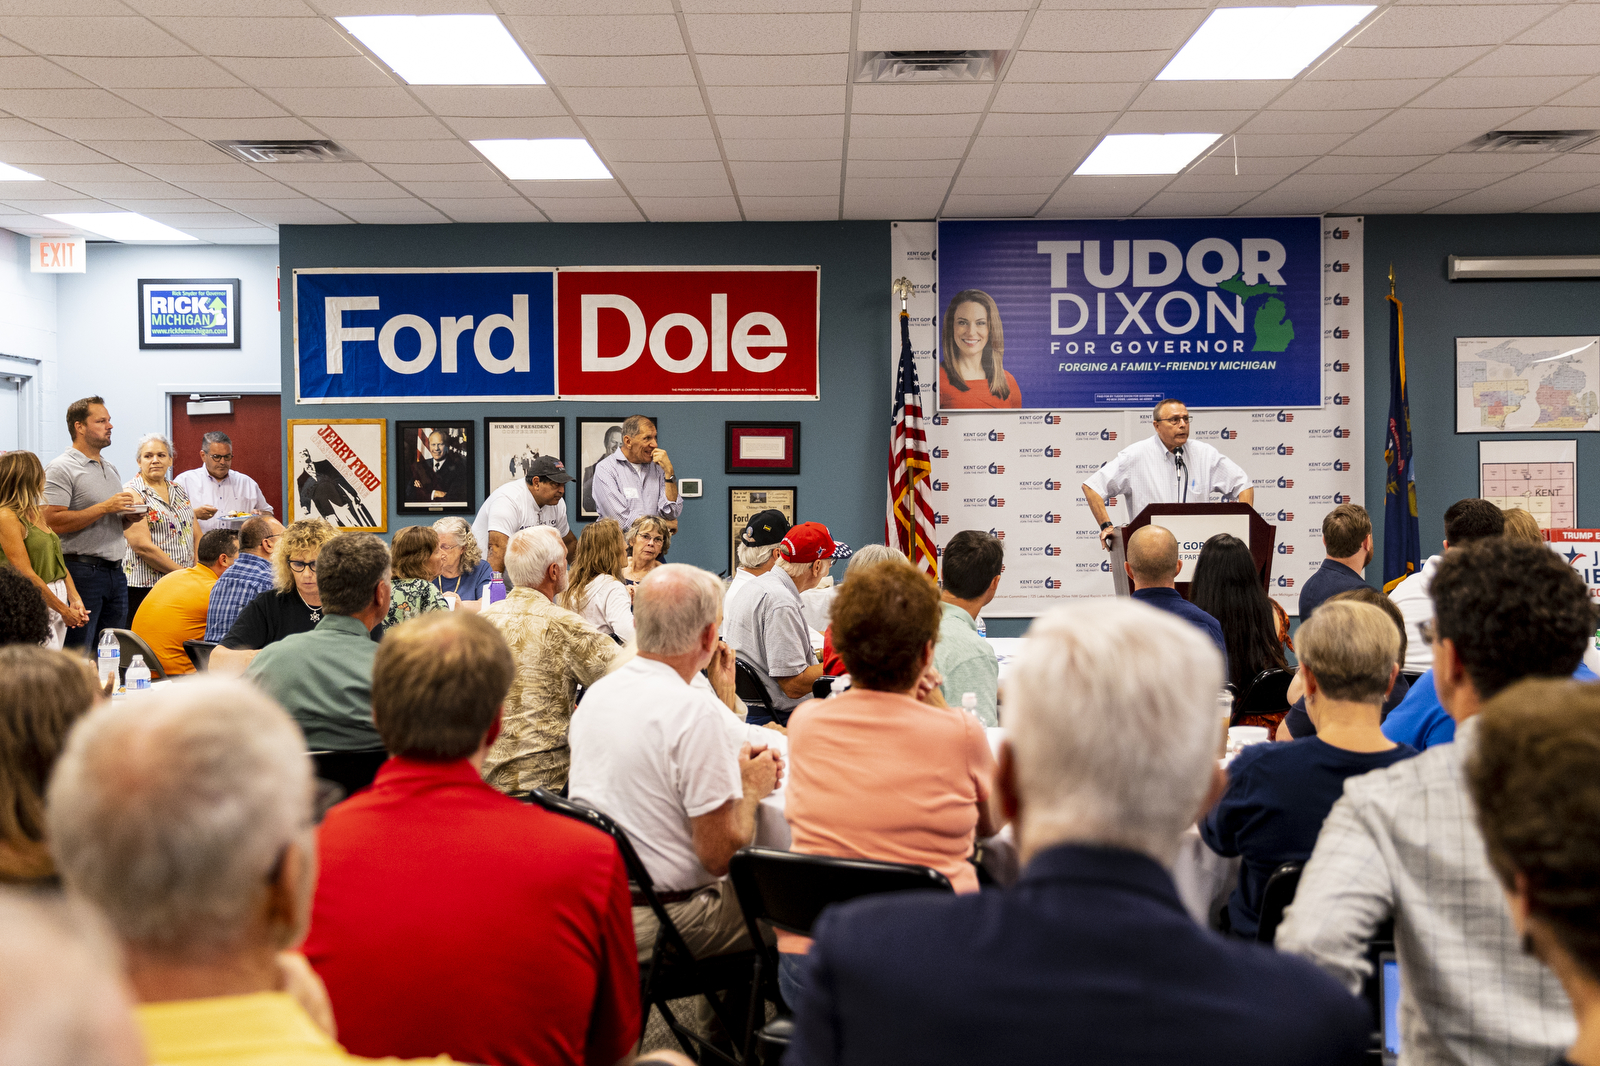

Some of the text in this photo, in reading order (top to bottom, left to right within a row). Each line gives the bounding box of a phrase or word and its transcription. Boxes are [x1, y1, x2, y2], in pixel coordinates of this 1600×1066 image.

[40, 242, 76, 267] EXIT
[1037, 237, 1287, 288] TUDOR
[152, 296, 209, 314] RICK
[1050, 290, 1244, 335] DIXON
[152, 314, 210, 326] MICHIGAN
[324, 294, 530, 374] Ford
[581, 293, 788, 374] Dole
[1050, 340, 1244, 354] FOR GOVERNOR
[1058, 360, 1276, 372] FORGING A FAMILY-FRIENDLY MICHIGAN
[316, 424, 381, 492] JERRY FORD
[1535, 488, 1560, 497] KENT
[734, 514, 749, 522] Ford
[1183, 542, 1205, 550] GOP
